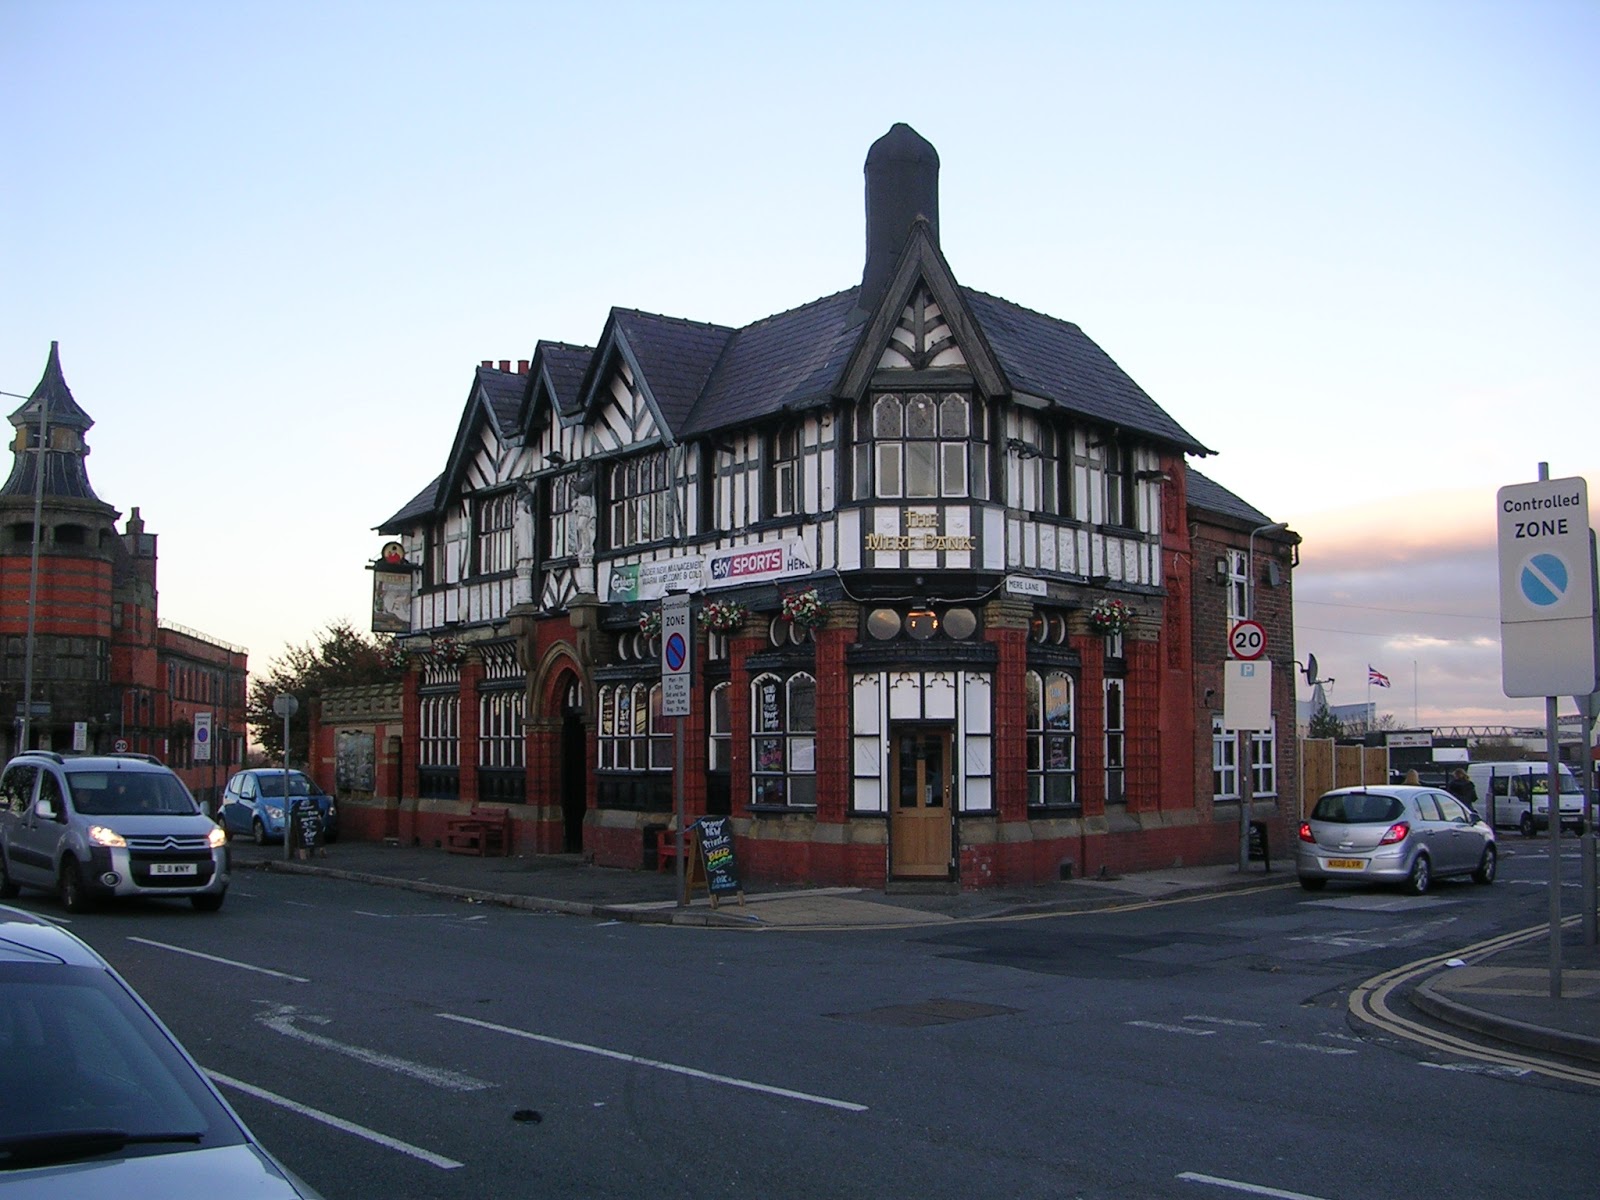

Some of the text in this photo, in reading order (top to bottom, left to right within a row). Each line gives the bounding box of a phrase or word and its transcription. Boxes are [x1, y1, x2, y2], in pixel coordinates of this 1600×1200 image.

[1503, 492, 1580, 513] Controlled
[1515, 519, 1568, 539] ZONE
[865, 533, 976, 550] MERE BANK
[713, 551, 781, 578] sky SPORTS
[688, 570, 702, 579] COLD
[1025, 582, 1040, 591] LANE
[662, 601, 690, 611] Controlled
[666, 614, 685, 627] ZONE
[1235, 632, 1261, 648] 20
